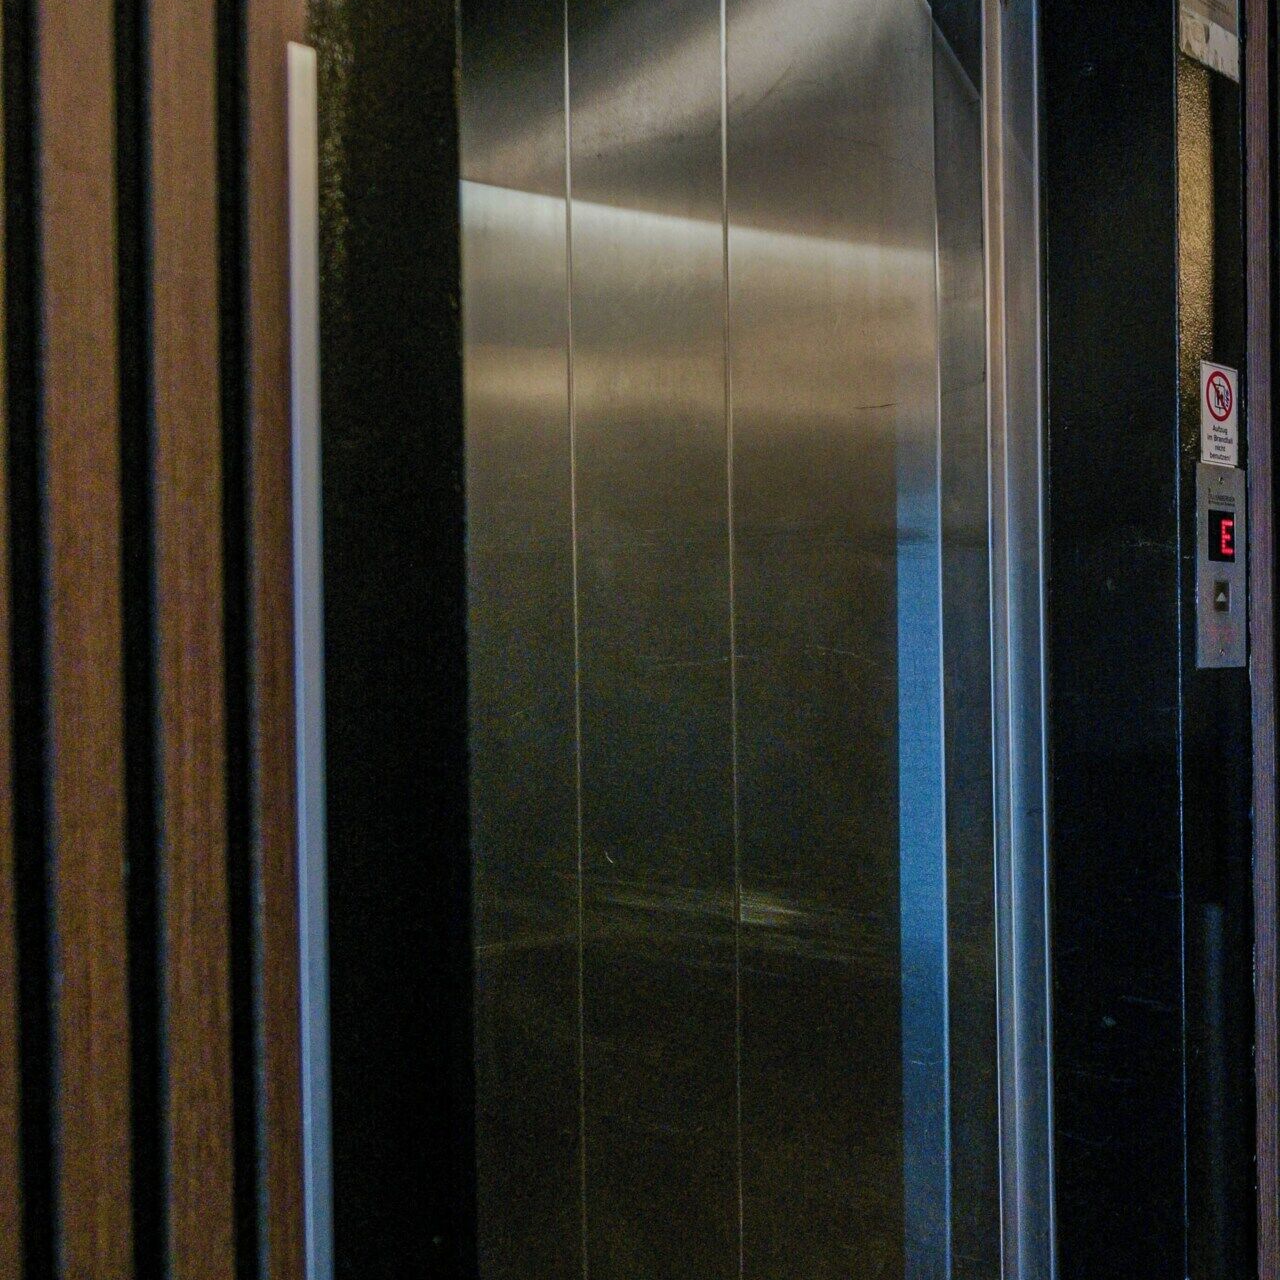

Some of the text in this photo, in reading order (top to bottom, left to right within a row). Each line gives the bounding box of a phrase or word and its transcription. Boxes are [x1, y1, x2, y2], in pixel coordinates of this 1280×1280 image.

[1212, 425, 1228, 435] Aufzug
[1213, 435, 1234, 444] Brandfall
[1214, 444, 1226, 452] nicht
[1220, 519, 1233, 554] E
